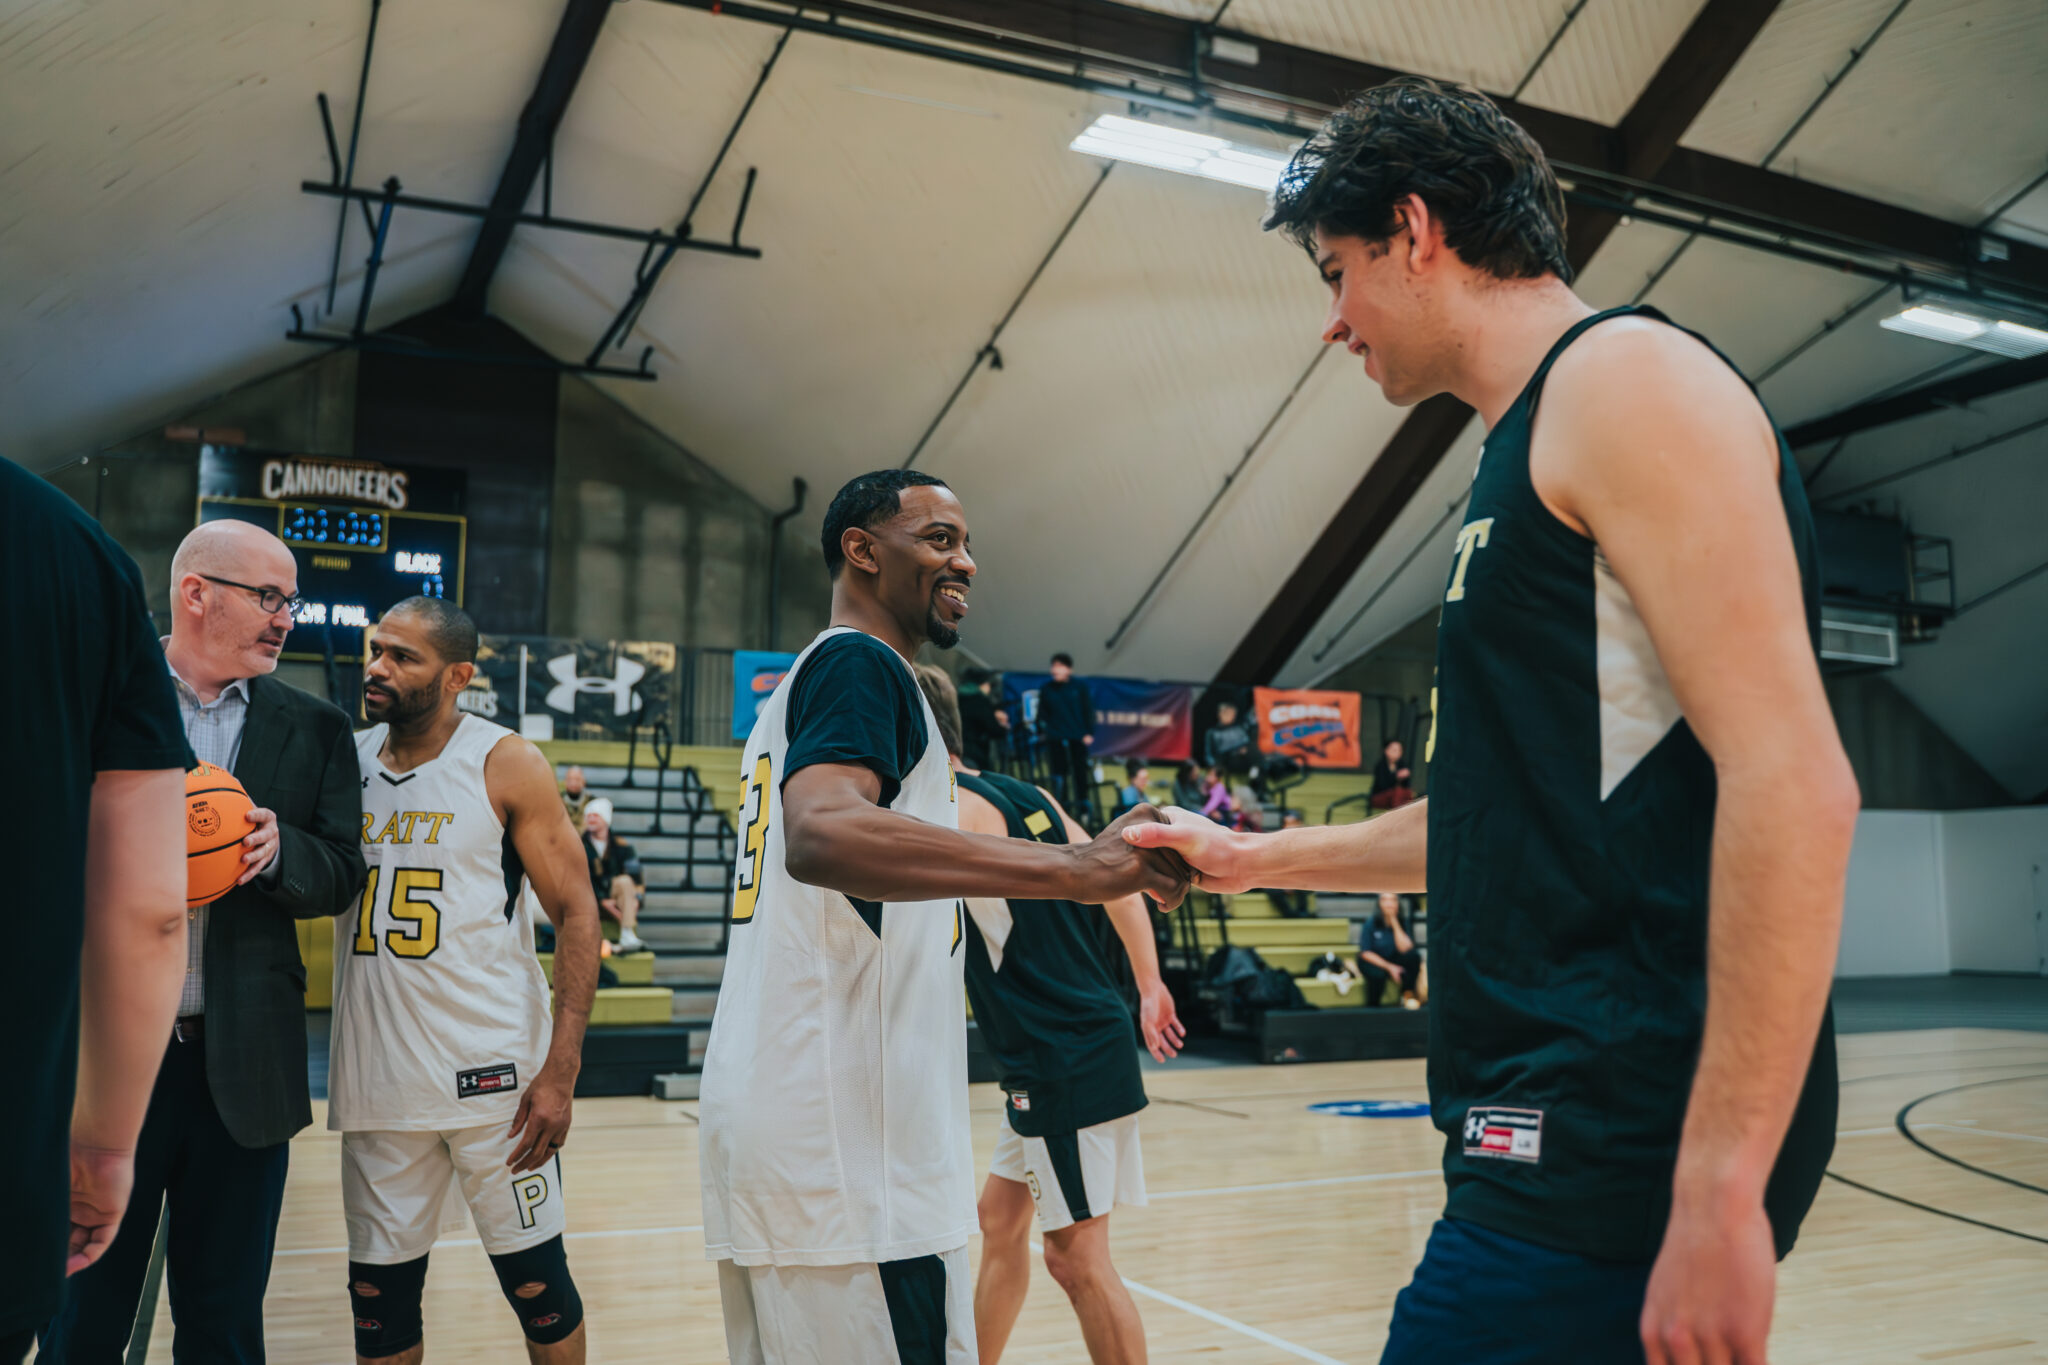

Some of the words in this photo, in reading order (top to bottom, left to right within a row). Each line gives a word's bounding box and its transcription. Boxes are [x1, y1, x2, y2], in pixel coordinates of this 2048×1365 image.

[263, 461, 408, 509] CANNONEERS
[353, 865, 444, 960] 15
[512, 1173, 548, 1230] P
